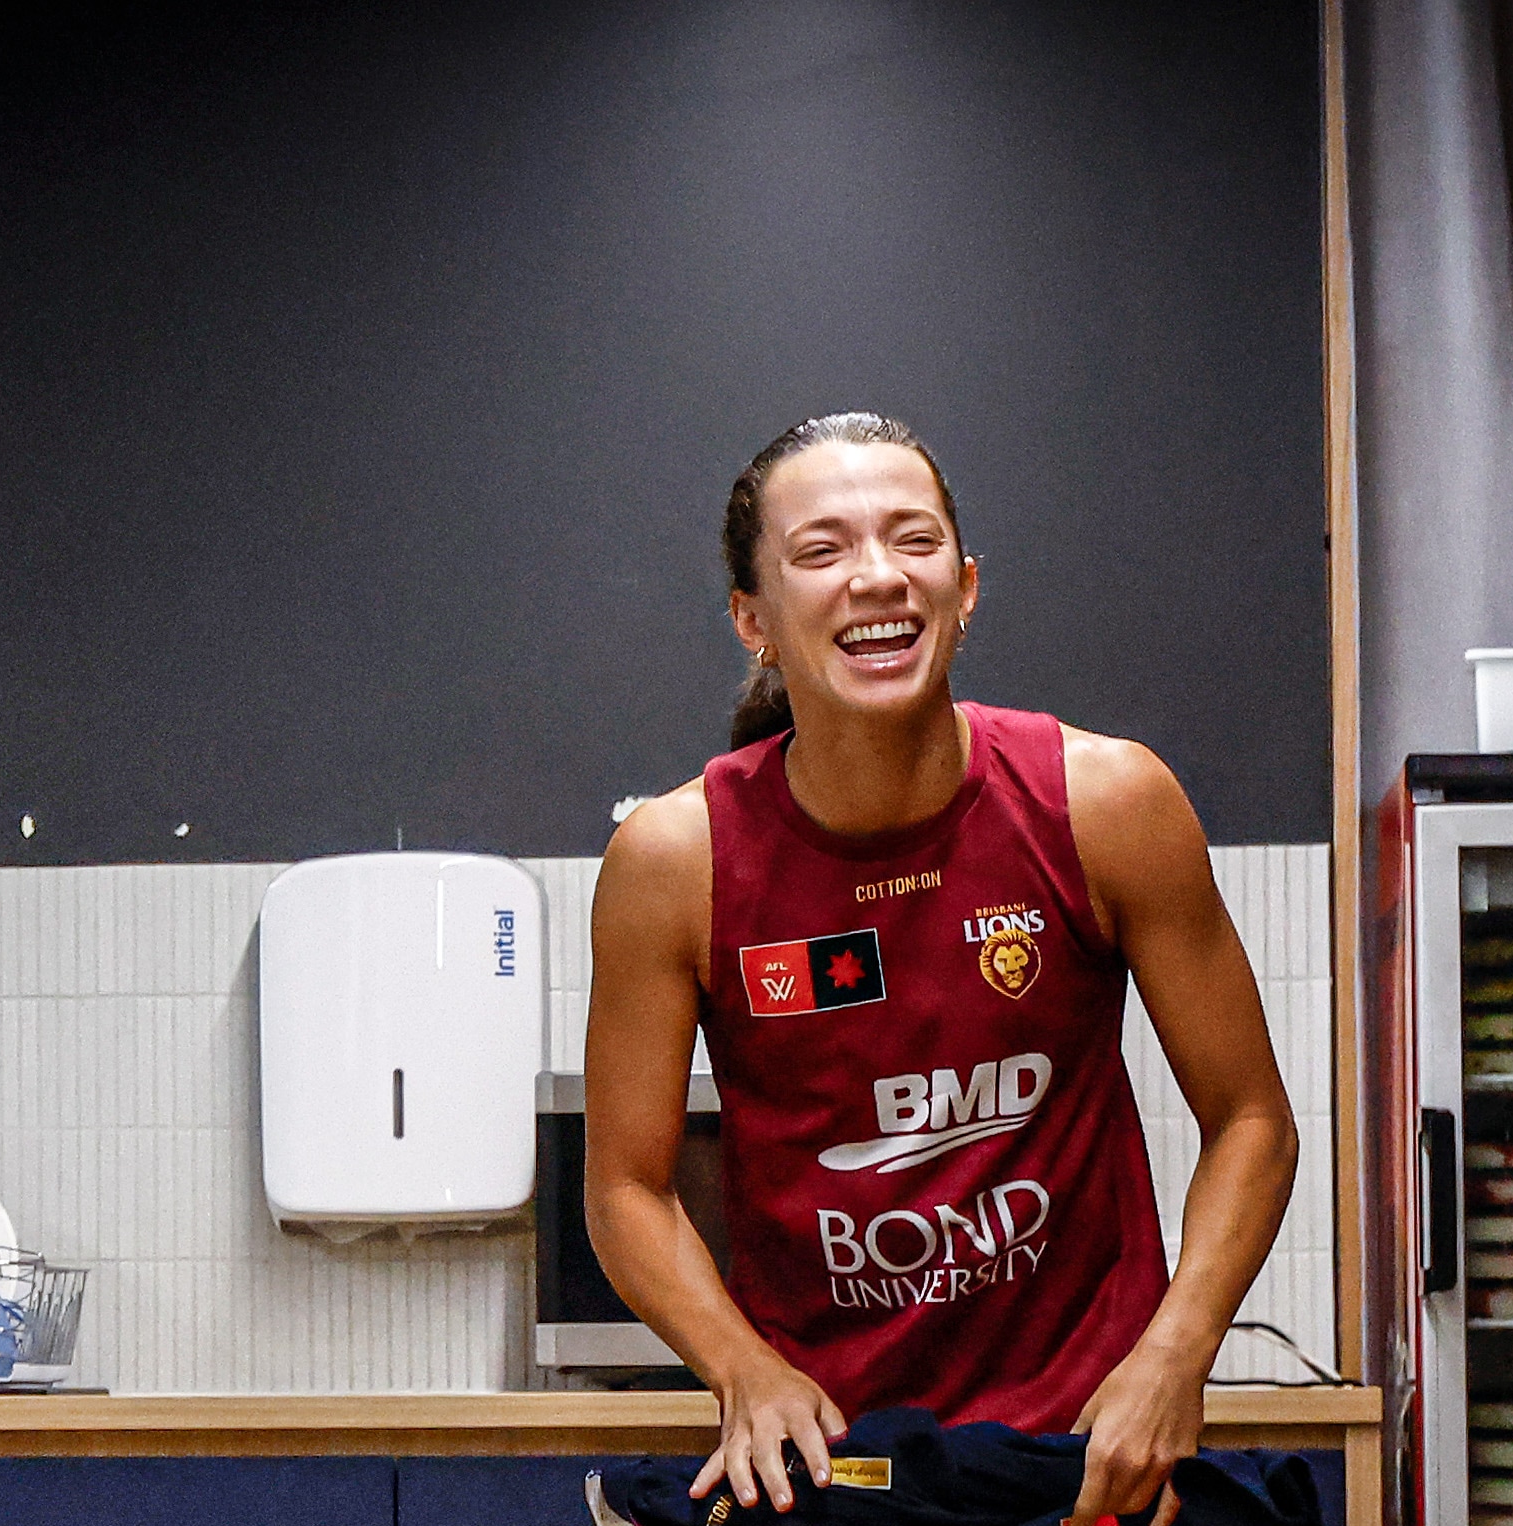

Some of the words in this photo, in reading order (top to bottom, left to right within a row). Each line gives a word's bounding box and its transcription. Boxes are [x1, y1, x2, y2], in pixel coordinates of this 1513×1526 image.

[494, 909, 515, 977] Initial
[963, 909, 1046, 943] LIONS
[765, 962, 789, 972] AFL
[873, 1052, 1053, 1134] BMD
[816, 1179, 1050, 1274] BOND
[830, 1240, 1048, 1309] UNIVERSITY
